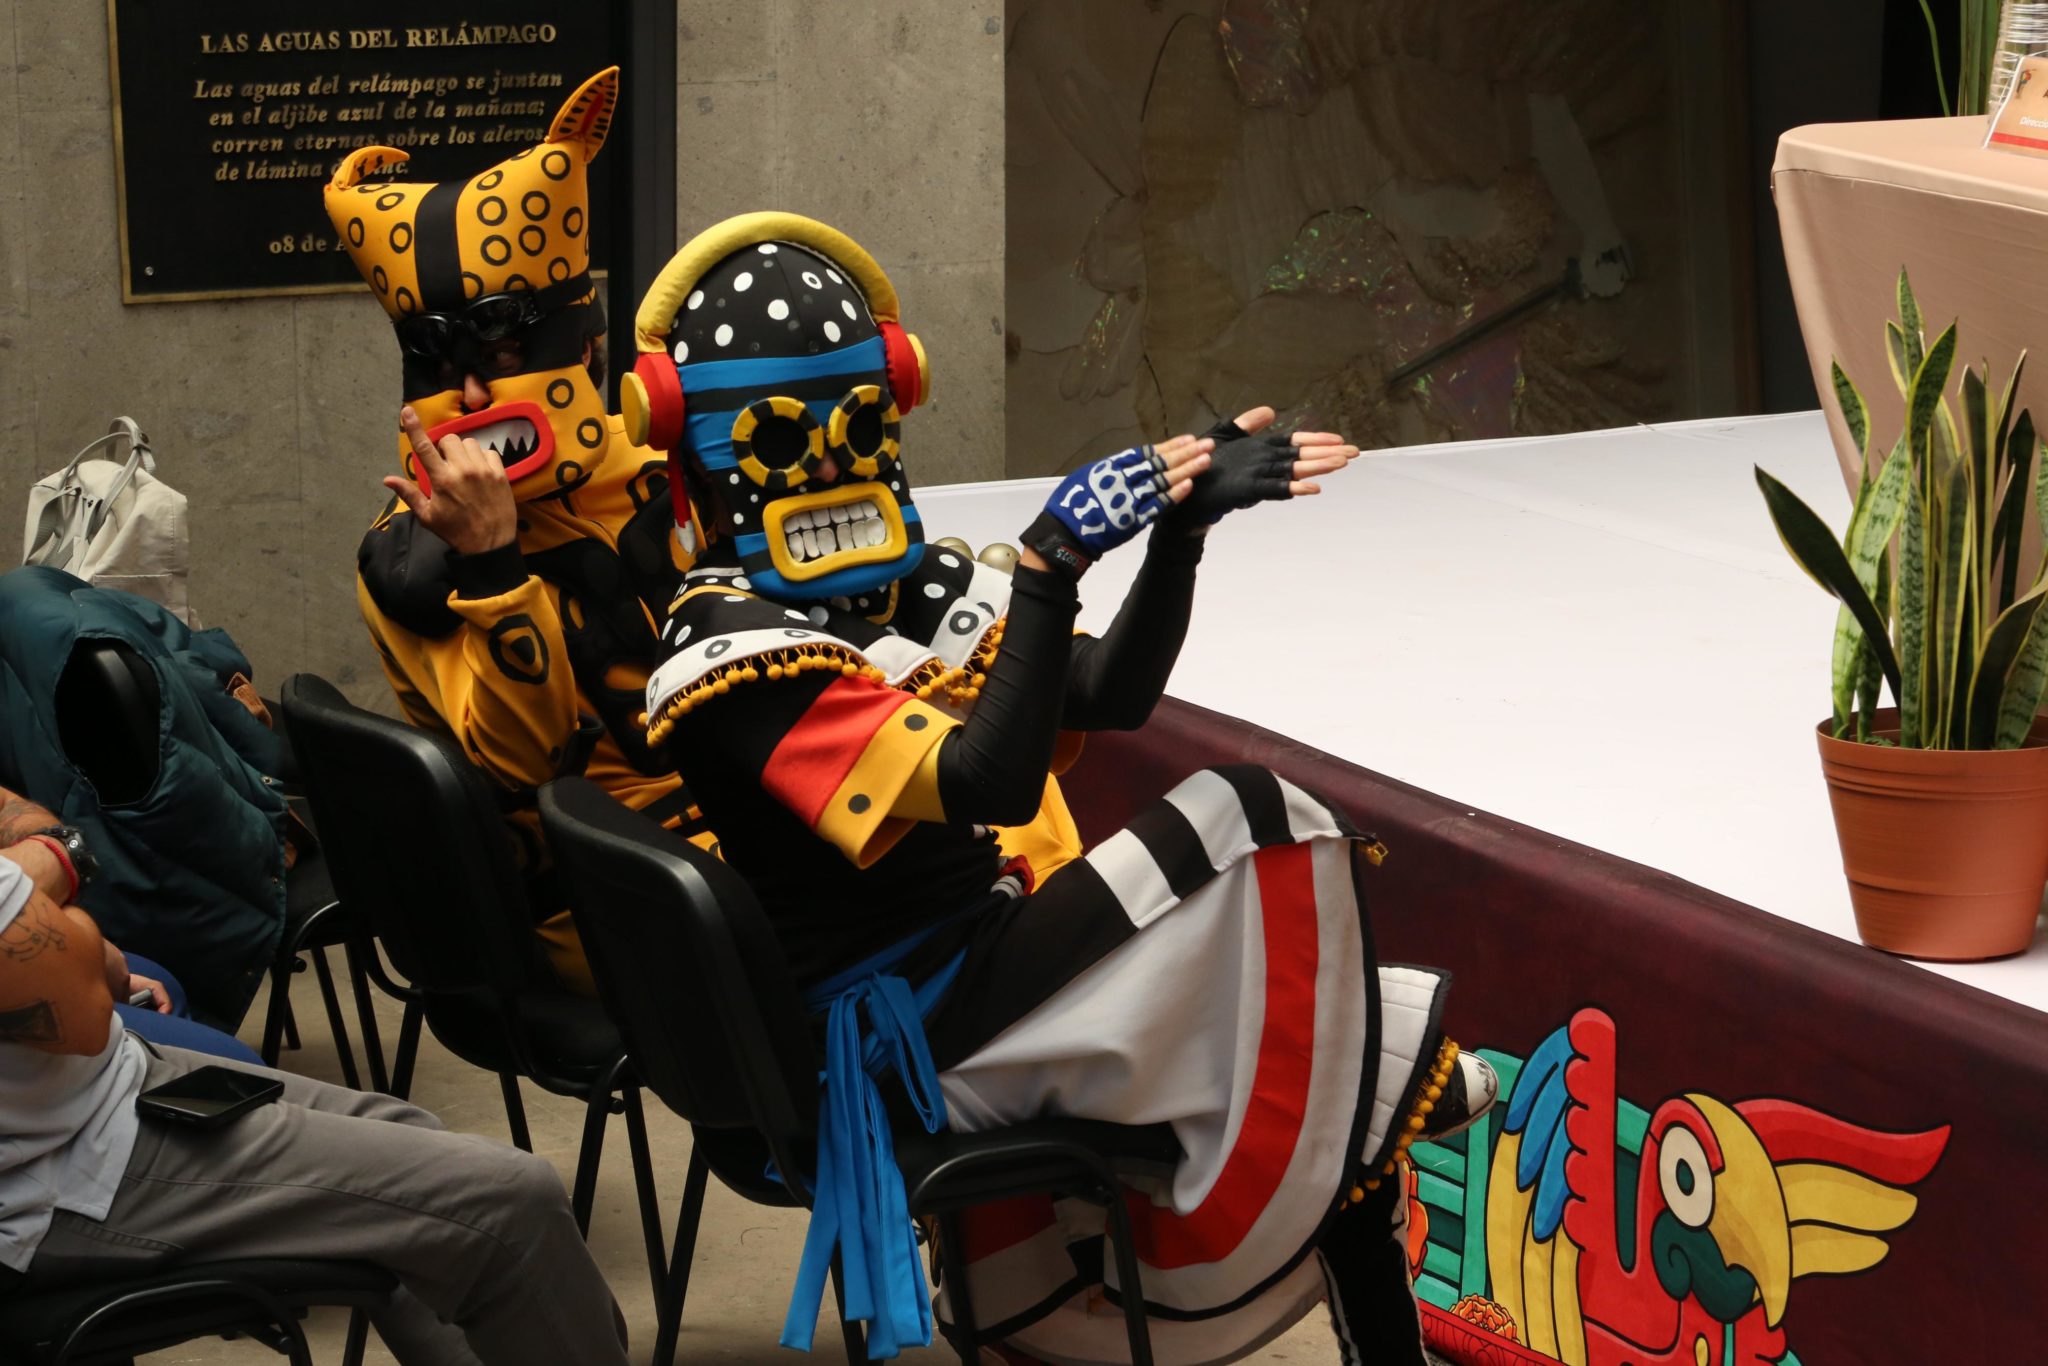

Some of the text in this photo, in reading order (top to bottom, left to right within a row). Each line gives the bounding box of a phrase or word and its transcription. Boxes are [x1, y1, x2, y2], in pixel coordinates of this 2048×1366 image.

[201, 21, 557, 53] LAS AGUAS DEL RELÁMPAGO
[194, 70, 563, 103] Las aguas del relámpago se juntan
[209, 99, 545, 130] en el aljibe azul de la mañana;
[212, 138, 284, 154] corren
[386, 126, 440, 147] sobre
[448, 125, 476, 145] los
[215, 161, 239, 181] de
[246, 160, 323, 180] lámina
[301, 233, 327, 252] de
